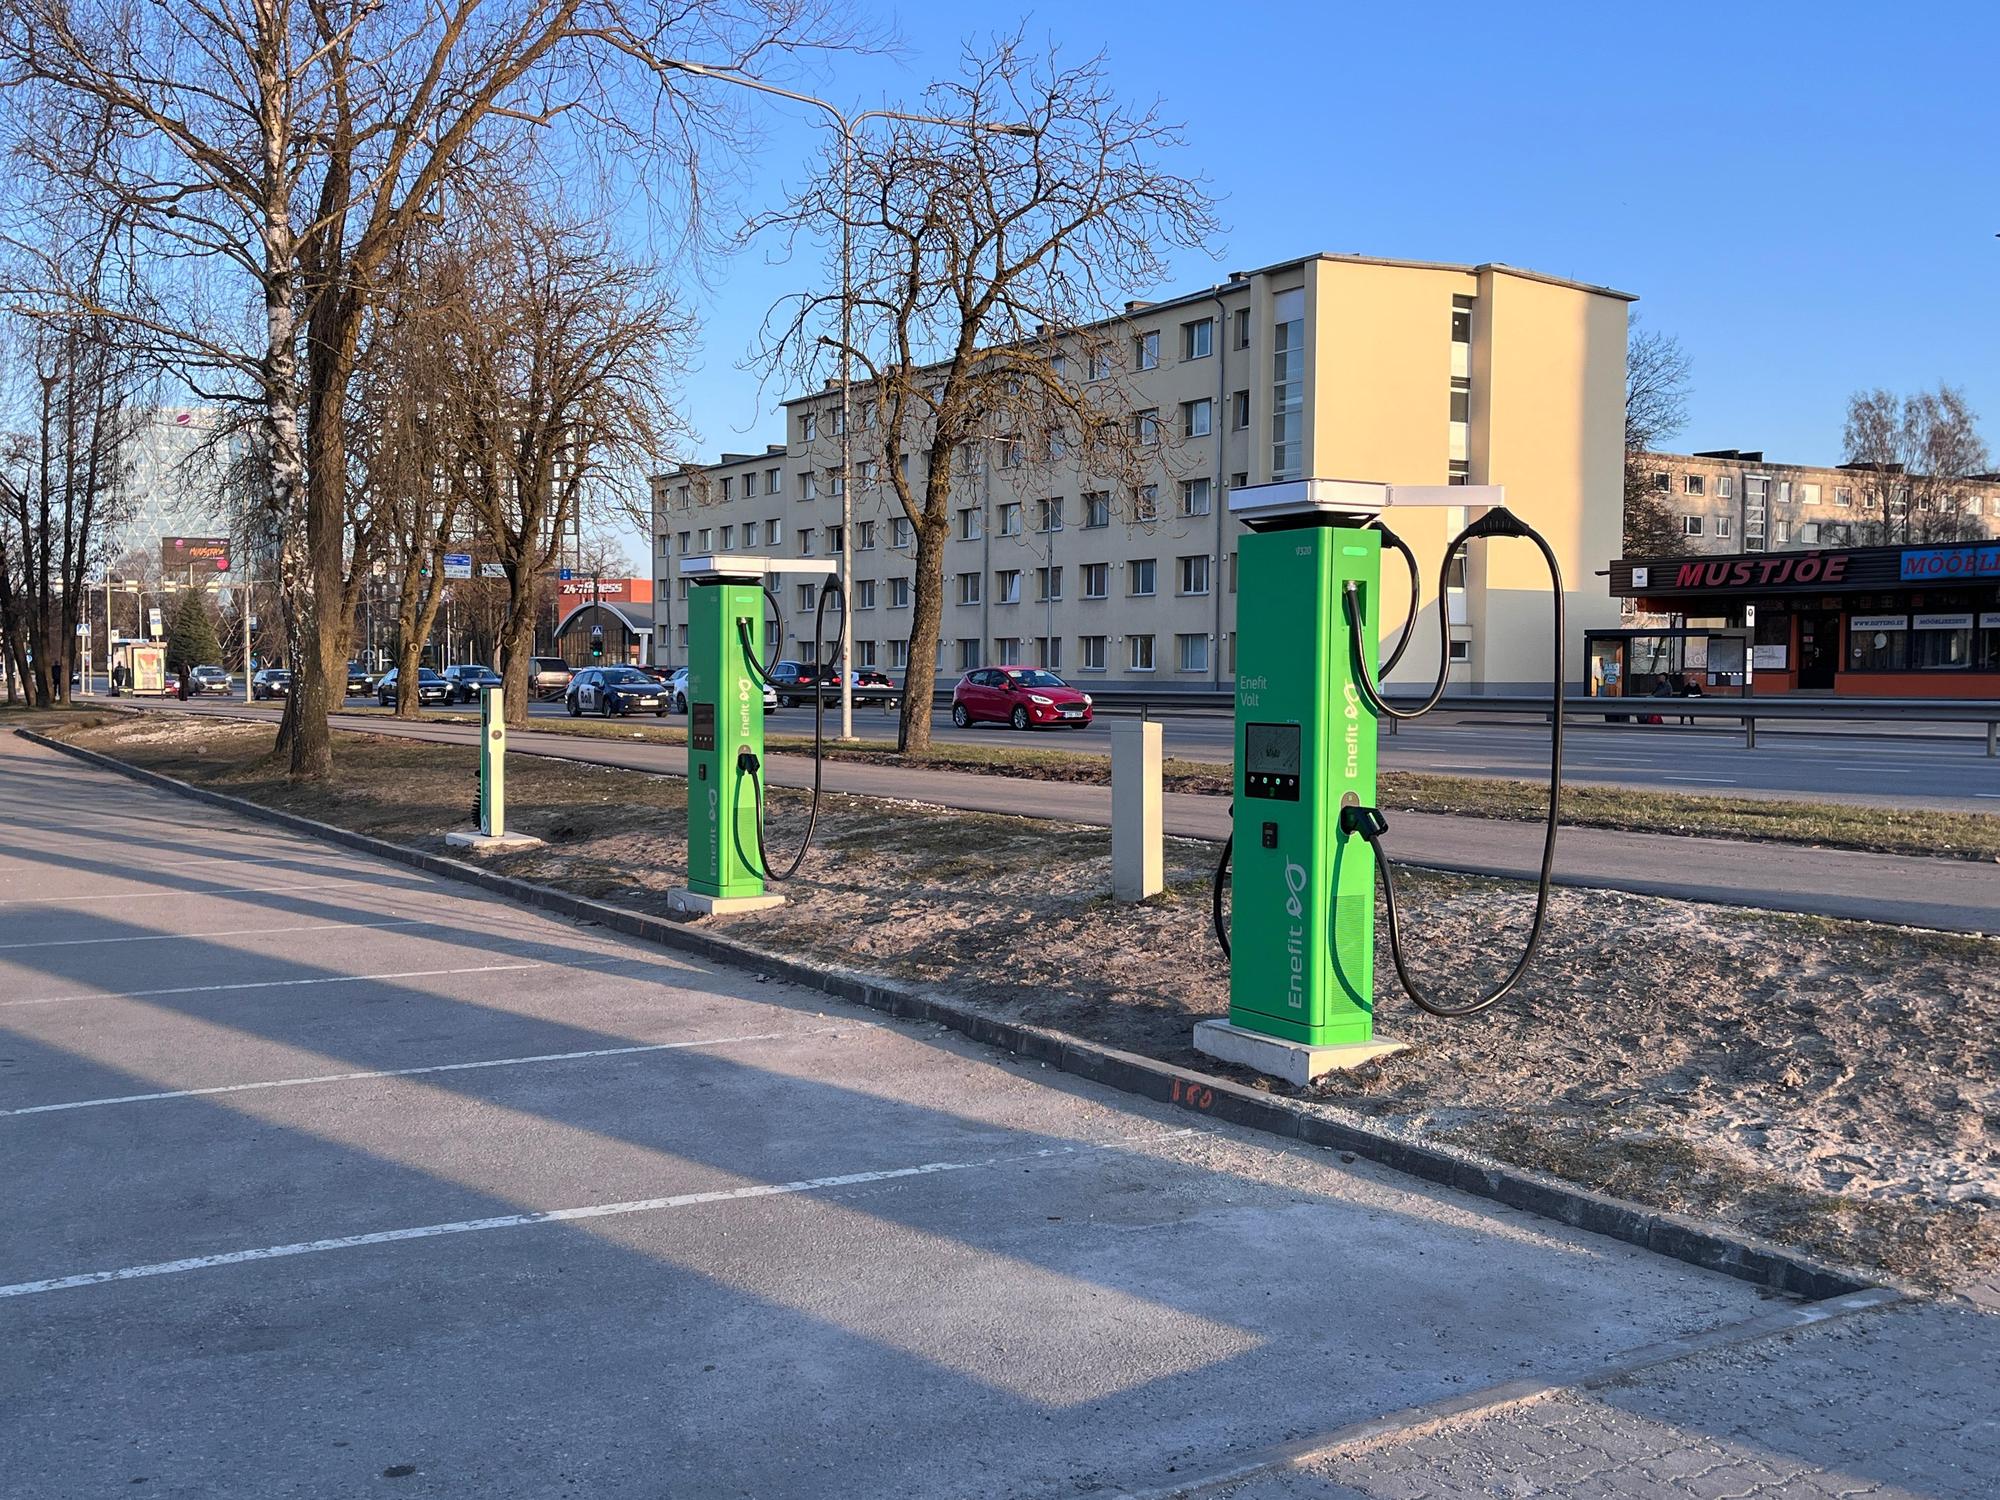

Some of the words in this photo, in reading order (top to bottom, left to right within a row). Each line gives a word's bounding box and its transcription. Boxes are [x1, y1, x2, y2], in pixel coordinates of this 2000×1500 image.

[1675, 550, 1849, 588] MUSTJÕE
[1240, 676, 1267, 690] Enefit
[1240, 693, 1259, 706] Volt
[740, 704, 750, 736] Enefit
[1345, 724, 1359, 778] Enefit
[1288, 925, 1303, 1008] Enefit
